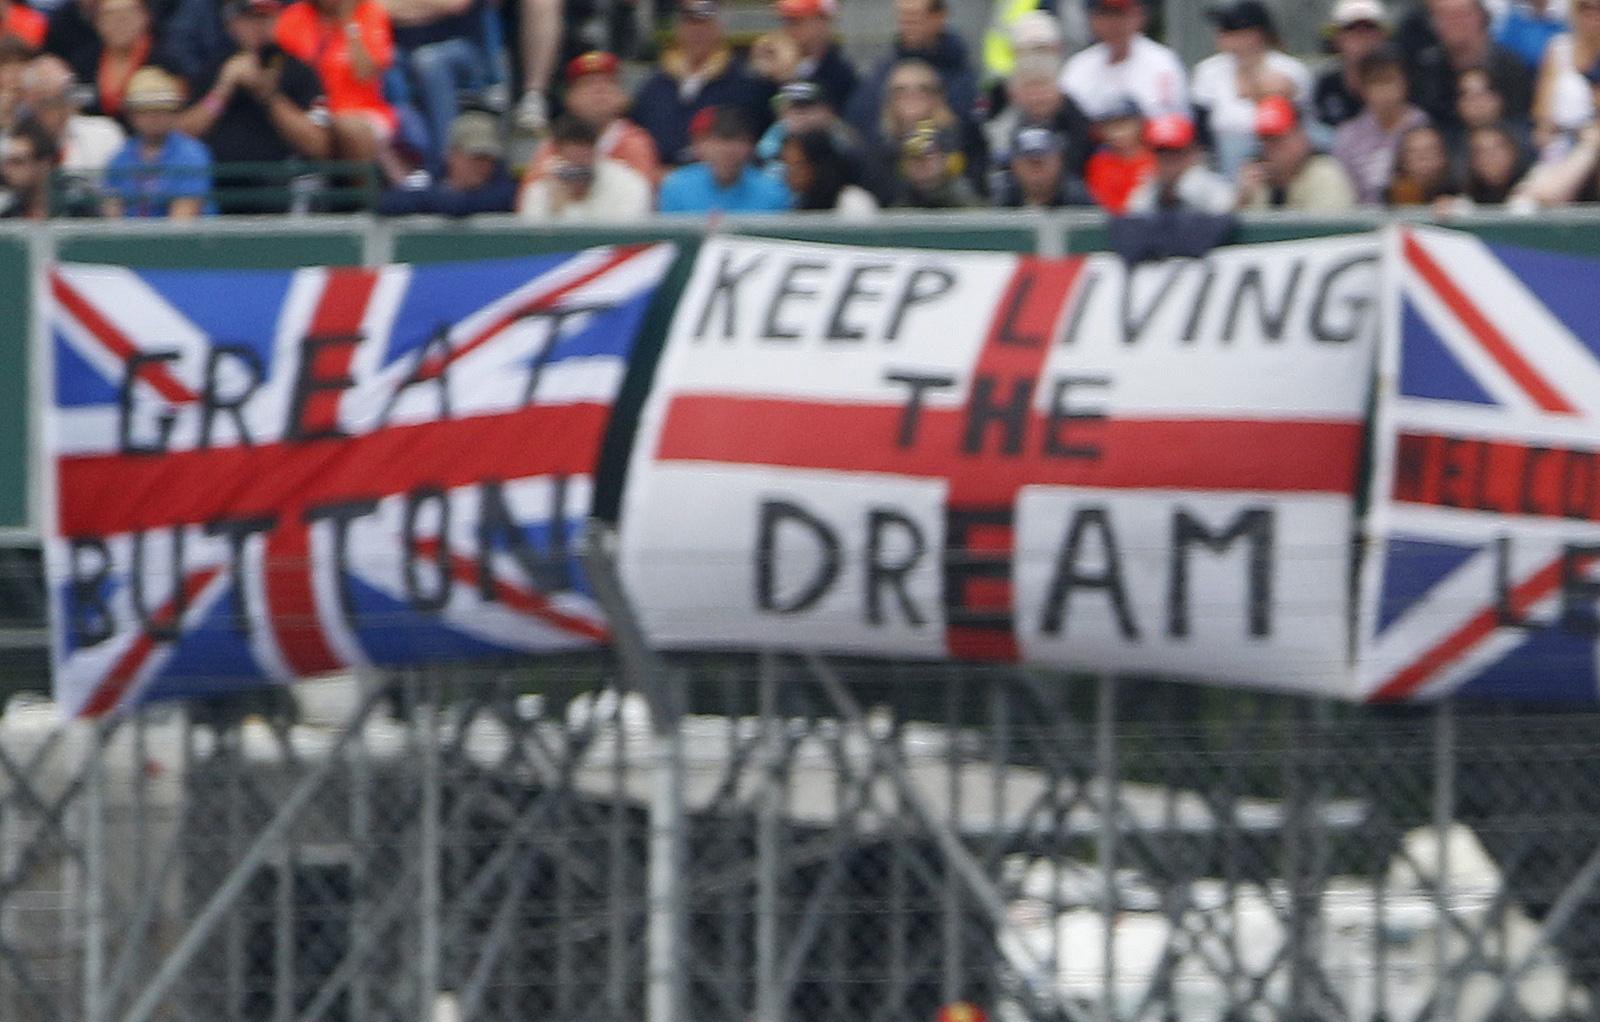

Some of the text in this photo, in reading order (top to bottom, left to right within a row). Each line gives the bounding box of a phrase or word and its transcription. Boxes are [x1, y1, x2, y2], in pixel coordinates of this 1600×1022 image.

[694, 248, 1382, 347] KEEP LIVING
[124, 303, 617, 455] GREAT
[882, 369, 1114, 458] THE
[70, 472, 570, 647] BUTTON
[755, 499, 1276, 641] DREAM
